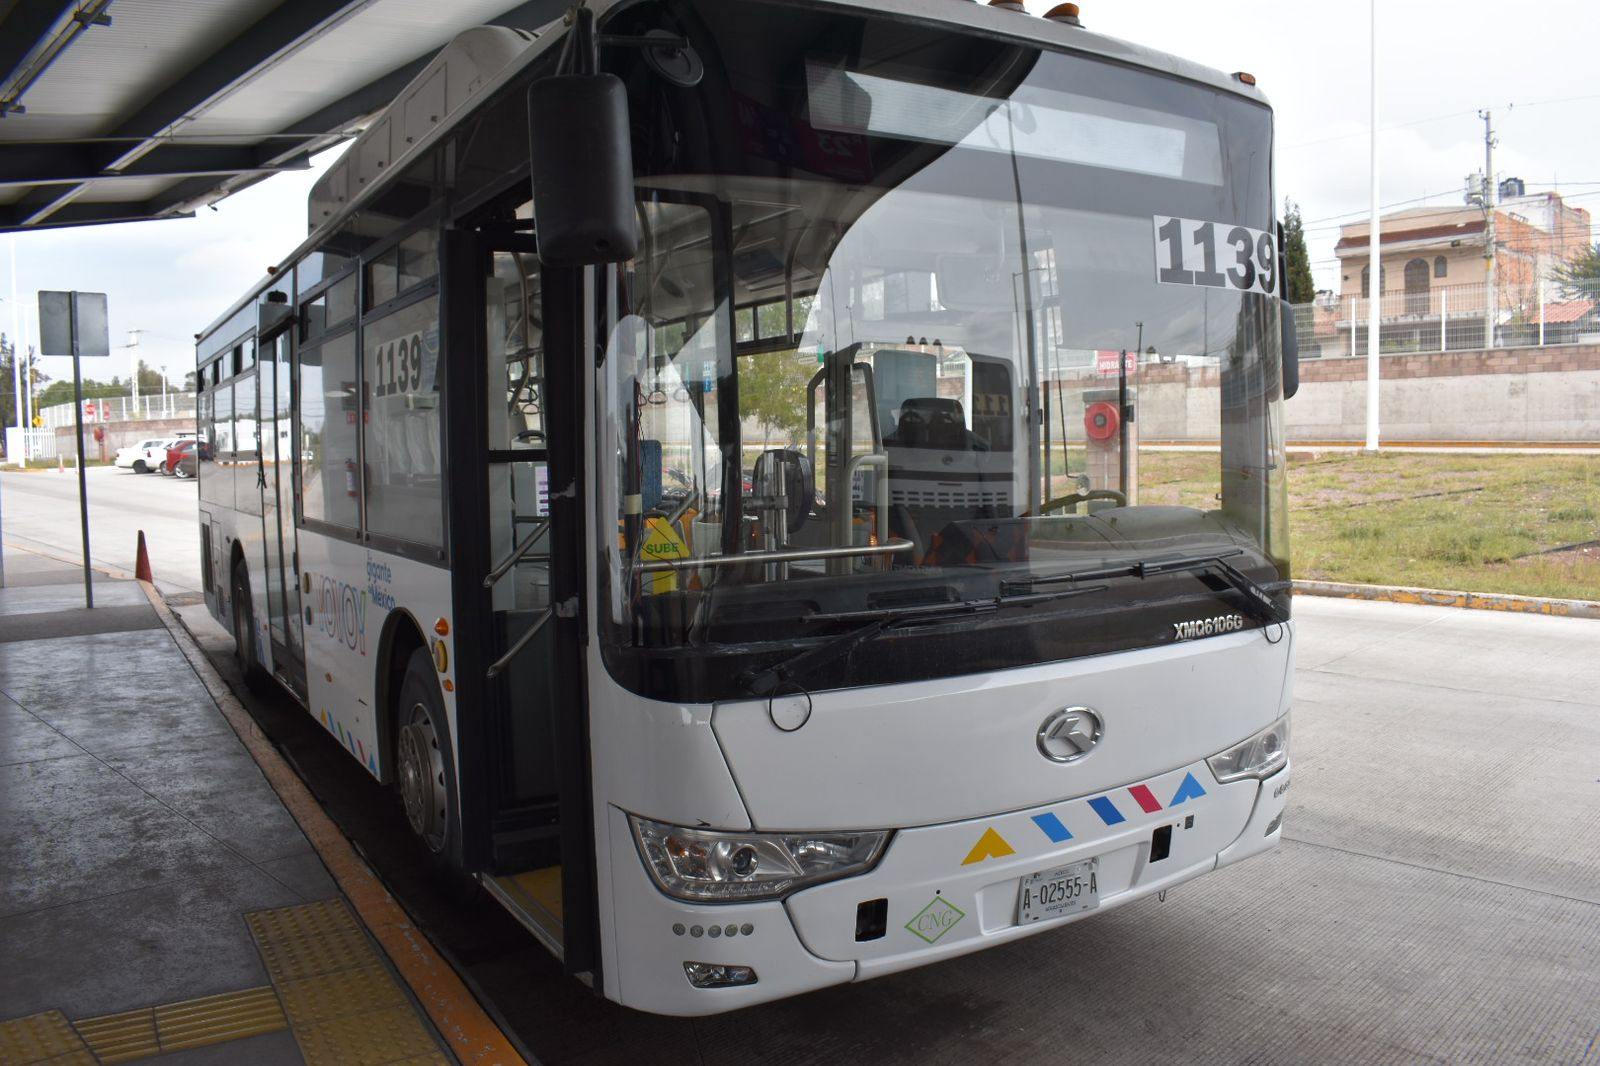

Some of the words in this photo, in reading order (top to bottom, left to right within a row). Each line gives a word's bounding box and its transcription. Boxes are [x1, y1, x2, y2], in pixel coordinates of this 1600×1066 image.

[1159, 217, 1276, 294] 1139
[376, 334, 422, 397] 1139
[1099, 359, 1133, 369] HIDRATE
[646, 542, 678, 553] SUBE
[1173, 614, 1243, 640] XMQ6106G
[1023, 872, 1097, 910] A-02555-A
[917, 910, 952, 931] CNG
